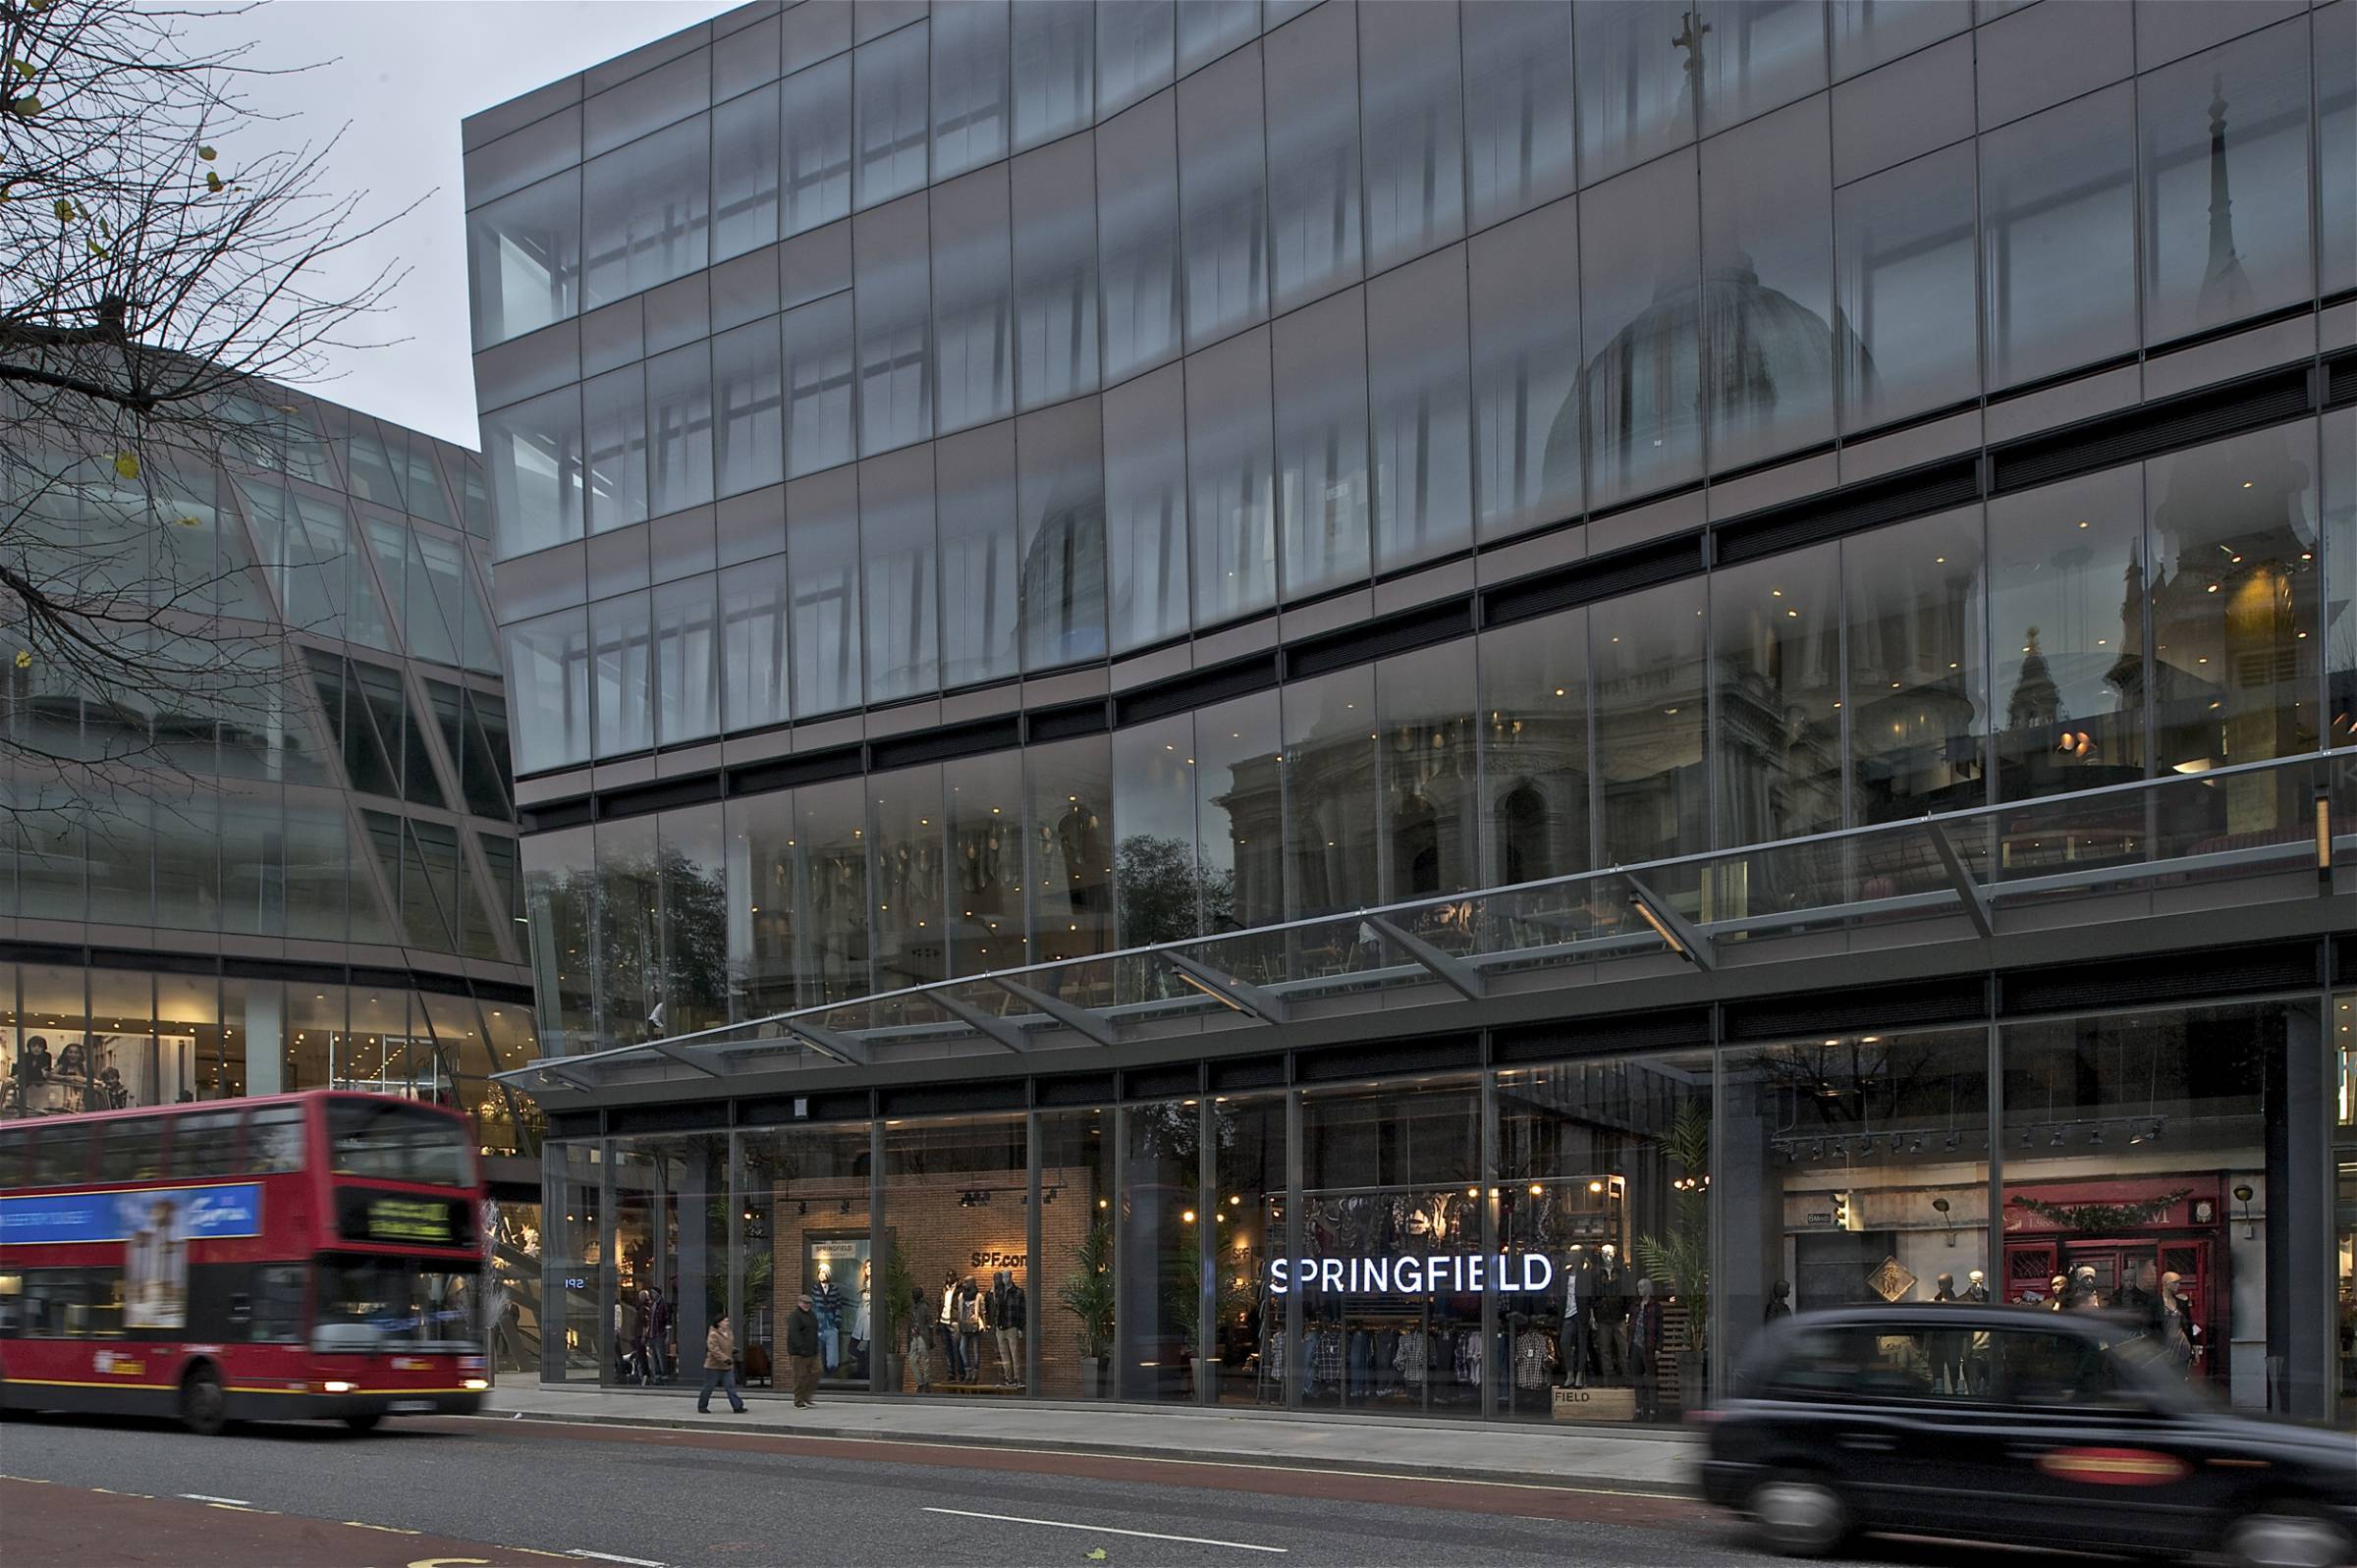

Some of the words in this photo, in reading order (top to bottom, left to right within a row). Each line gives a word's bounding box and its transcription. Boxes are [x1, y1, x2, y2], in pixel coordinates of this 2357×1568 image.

[1233, 1247, 1250, 1260] SPF
[1269, 1253, 1554, 1294] SPRINGFIELD
[1554, 1391, 1590, 1402] FIELD
